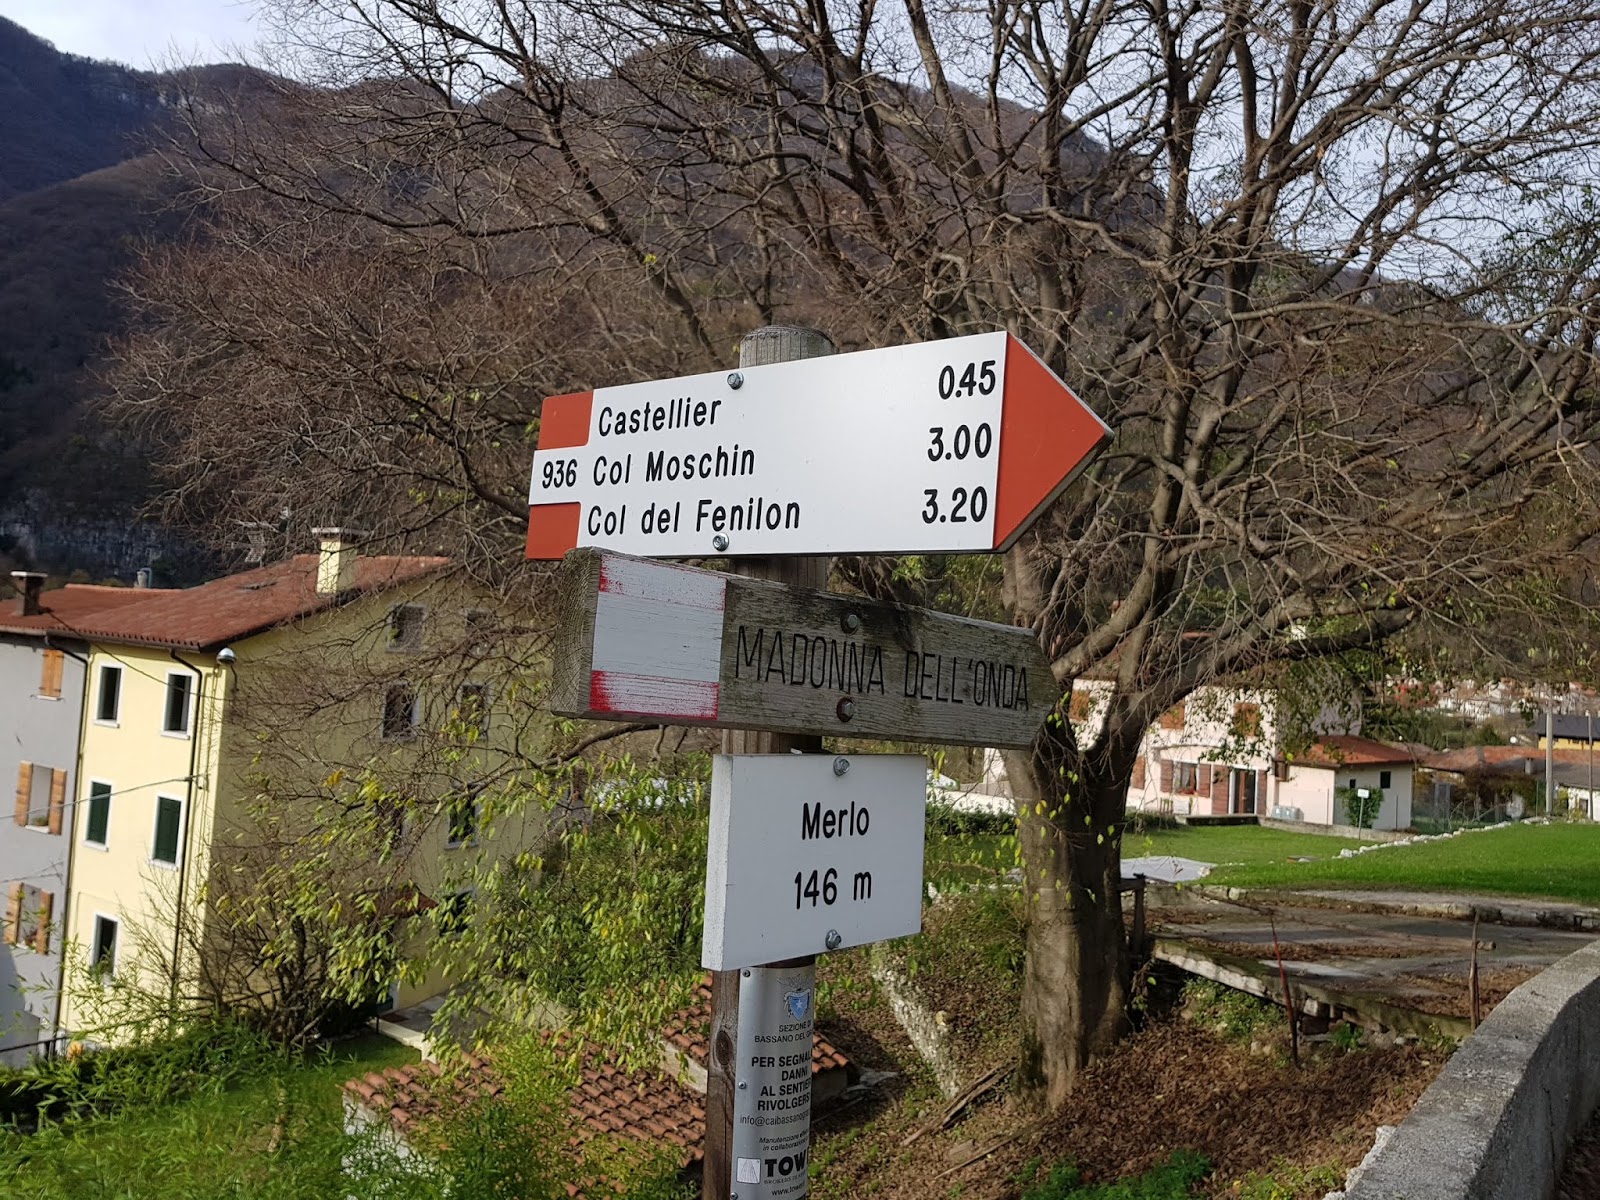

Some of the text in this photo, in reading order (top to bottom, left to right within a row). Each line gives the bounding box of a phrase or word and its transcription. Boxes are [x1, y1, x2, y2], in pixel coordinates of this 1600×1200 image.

[599, 360, 996, 437] Castellier 0.45
[593, 422, 992, 486] Col Moschin 3.00
[542, 458, 578, 489] 936
[587, 485, 988, 536] Col del Fenilon 3.20
[735, 625, 1029, 711] MADONNA DELL'ONDA
[802, 801, 870, 840] Merlo
[794, 868, 872, 909] 146 m
[755, 1034, 794, 1043] BASSANO
[794, 1031, 805, 1041] DEL
[779, 1021, 806, 1033] SEZIONE
[752, 1056, 775, 1068] PER
[782, 1065, 808, 1081] DANNI
[760, 1085, 776, 1097] AL
